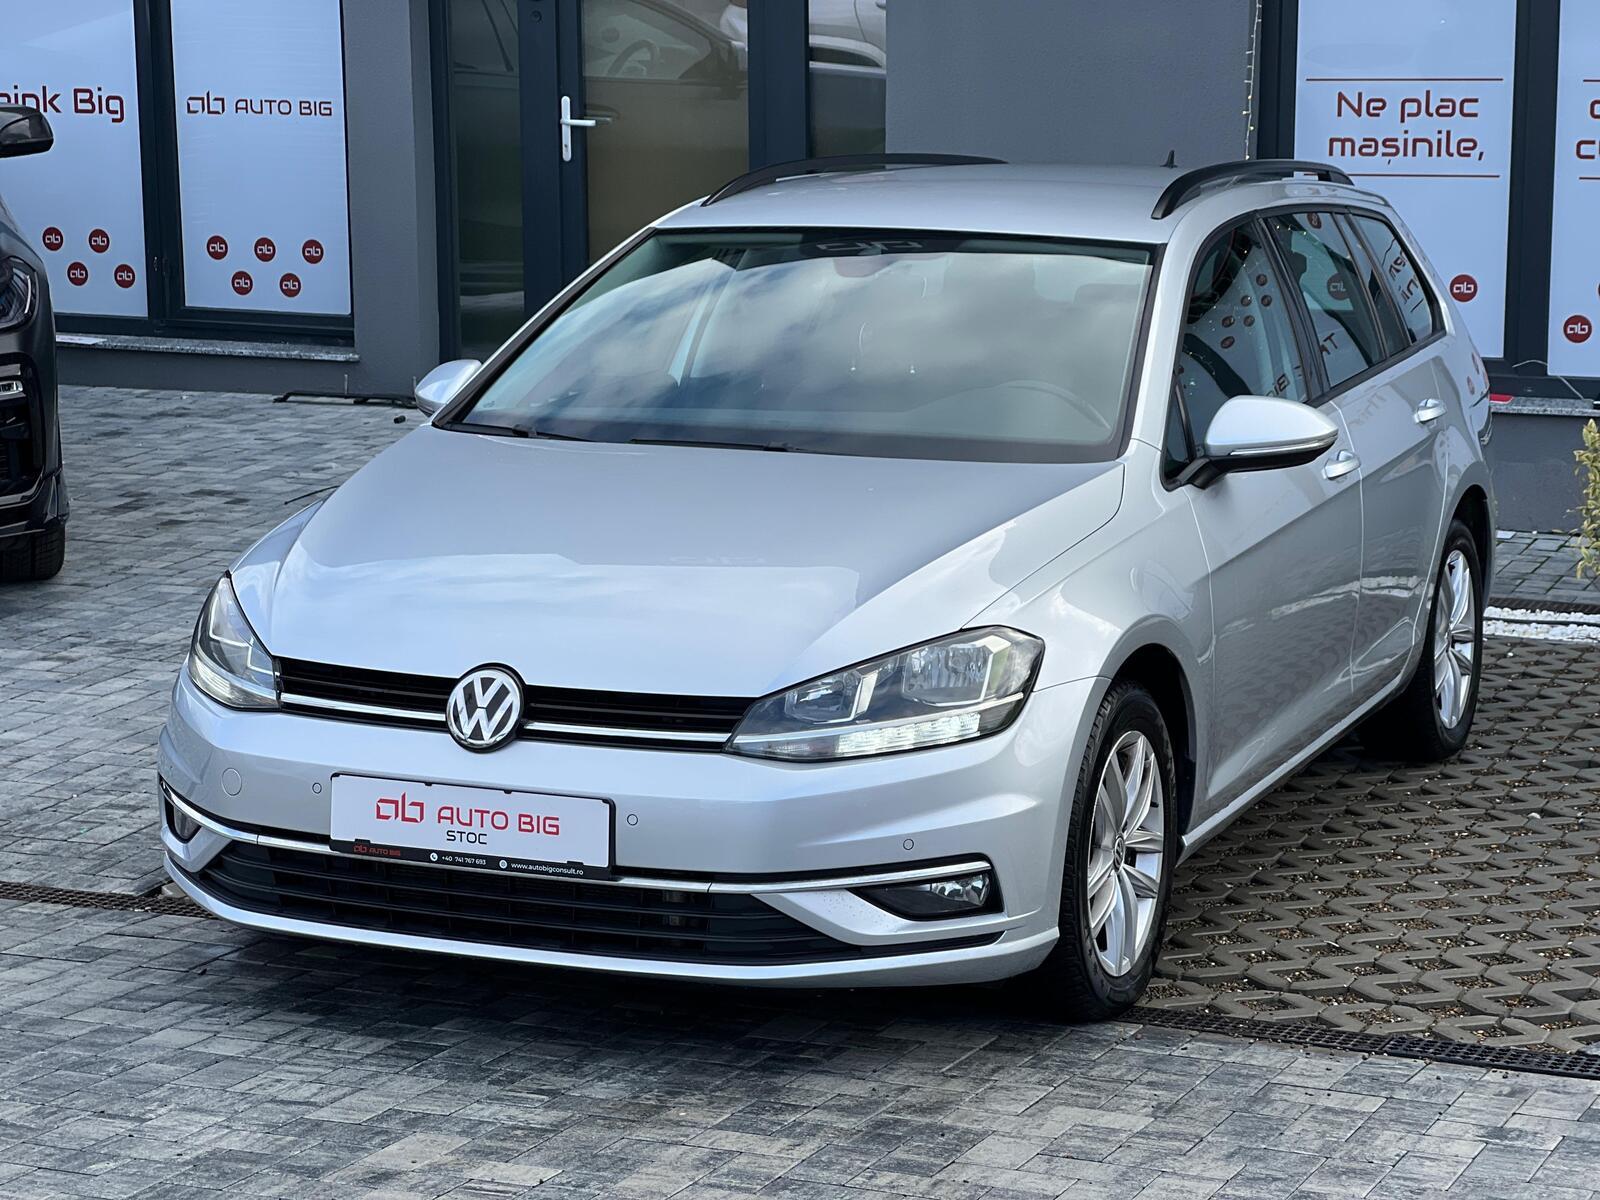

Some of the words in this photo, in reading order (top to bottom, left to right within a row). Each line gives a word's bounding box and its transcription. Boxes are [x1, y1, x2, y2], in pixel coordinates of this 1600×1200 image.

[73, 87, 124, 122] Big
[235, 99, 291, 115] AUTO
[299, 100, 332, 116] BIG
[1337, 91, 1387, 118] Ne
[1400, 90, 1479, 123] plac
[1328, 130, 1484, 165] mașinile,
[437, 806, 509, 830] AUTO
[518, 813, 560, 836] BIG
[446, 830, 488, 845] STOC
[369, 847, 388, 855] AUTO
[475, 858, 486, 866] 693
[511, 863, 584, 876] www.autobigconsult.ro
